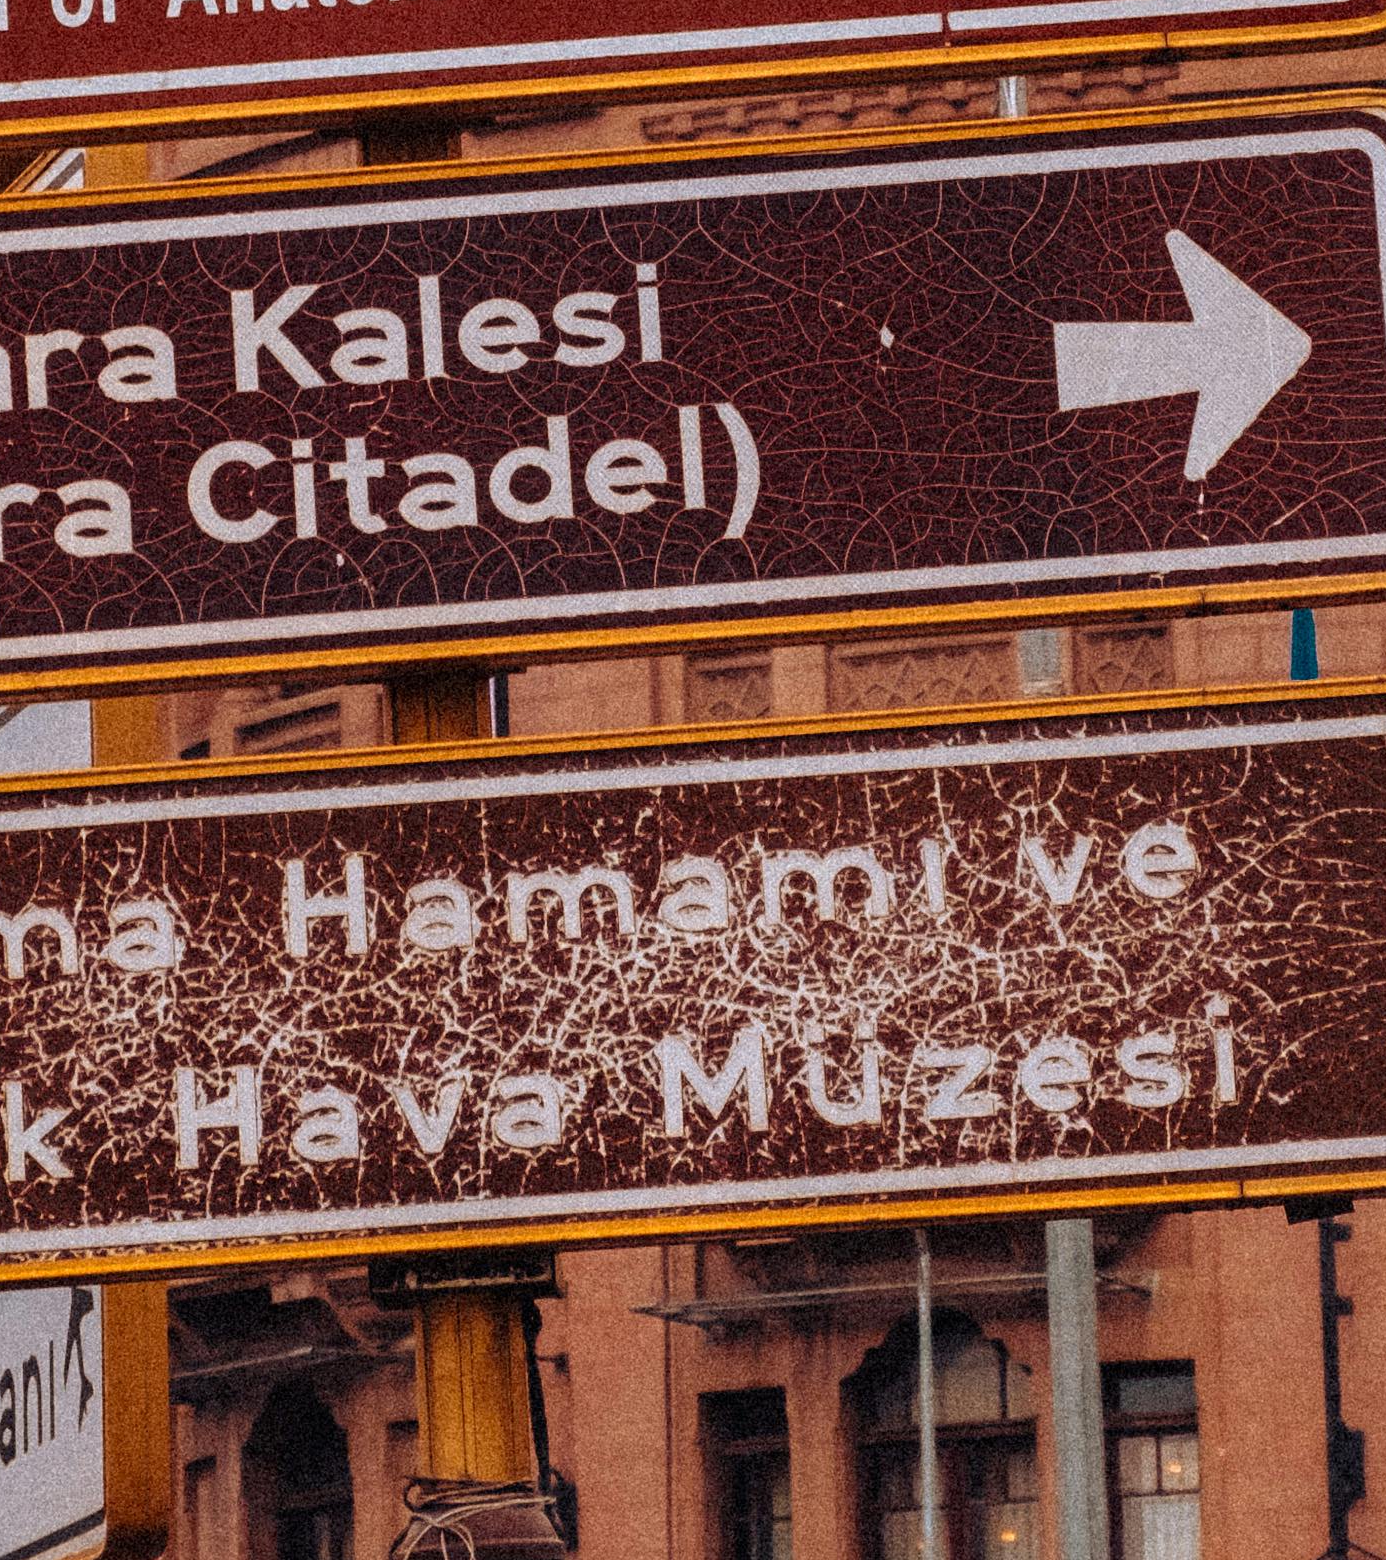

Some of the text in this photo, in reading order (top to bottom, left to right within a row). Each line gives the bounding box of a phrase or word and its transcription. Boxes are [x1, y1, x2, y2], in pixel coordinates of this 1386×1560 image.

[227, 260, 669, 394] Kalesi
[185, 400, 763, 548] Citadel)
[281, 825, 950, 968] Hamamı
[1017, 820, 1201, 908] ve
[173, 1056, 569, 1170] Hava
[657, 996, 1241, 1142] Müzesi
